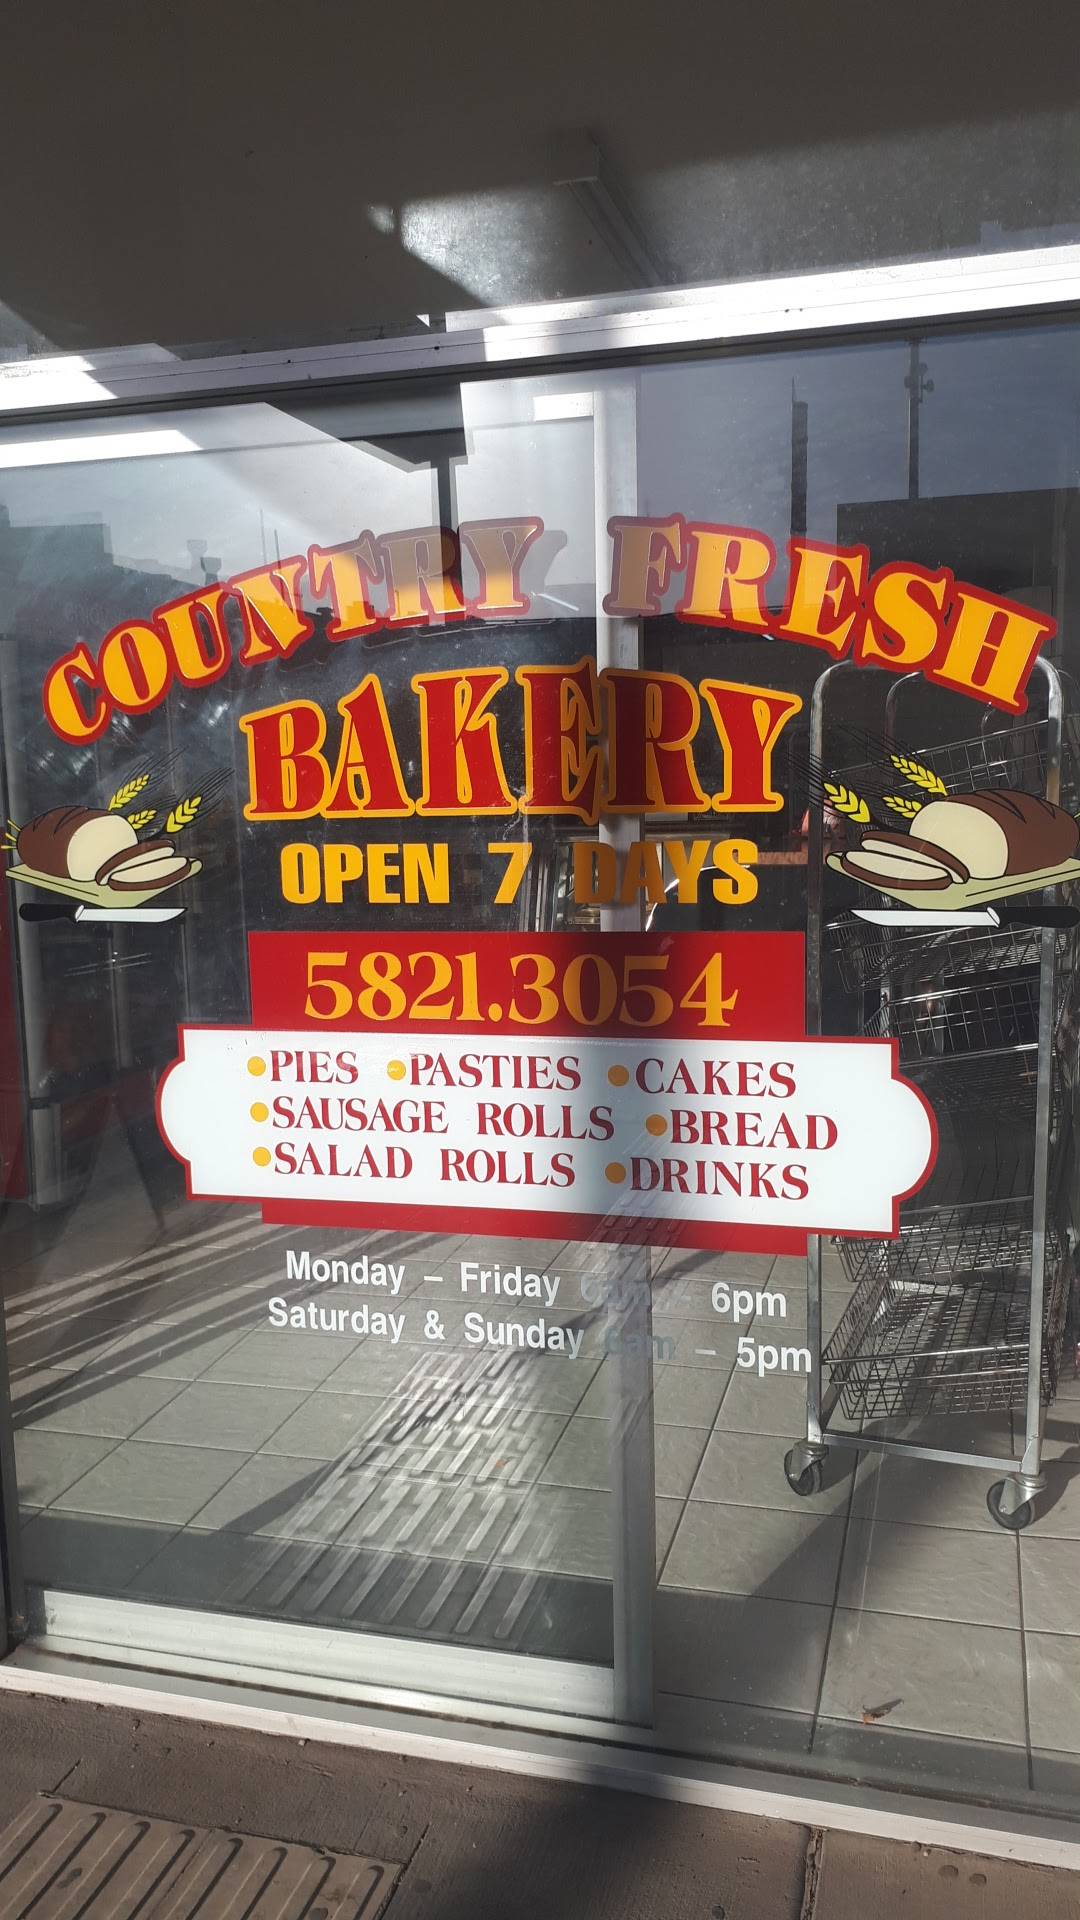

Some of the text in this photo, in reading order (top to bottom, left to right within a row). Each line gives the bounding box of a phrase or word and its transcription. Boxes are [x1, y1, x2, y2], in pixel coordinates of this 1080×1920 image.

[43, 512, 1058, 745] COUNTRY FRESH
[239, 655, 802, 827] BAKERY
[280, 838, 759, 906] OPEN 7 DAYS
[304, 951, 739, 1028] 5821.3054
[270, 1050, 797, 1099] PIES PASTIES CAKES
[272, 1095, 838, 1151] SAUSAGE ROLLS BREAD
[274, 1141, 809, 1201] SALAD ROLLS DRINKS
[286, 1250, 406, 1295] Monday
[460, 1261, 560, 1307] Friday
[711, 1282, 787, 1323] 6pm
[268, 1297, 406, 1344] Saturday
[424, 1309, 446, 1340] &
[464, 1312, 585, 1360] Sunday
[736, 1337, 812, 1378] 5pm
